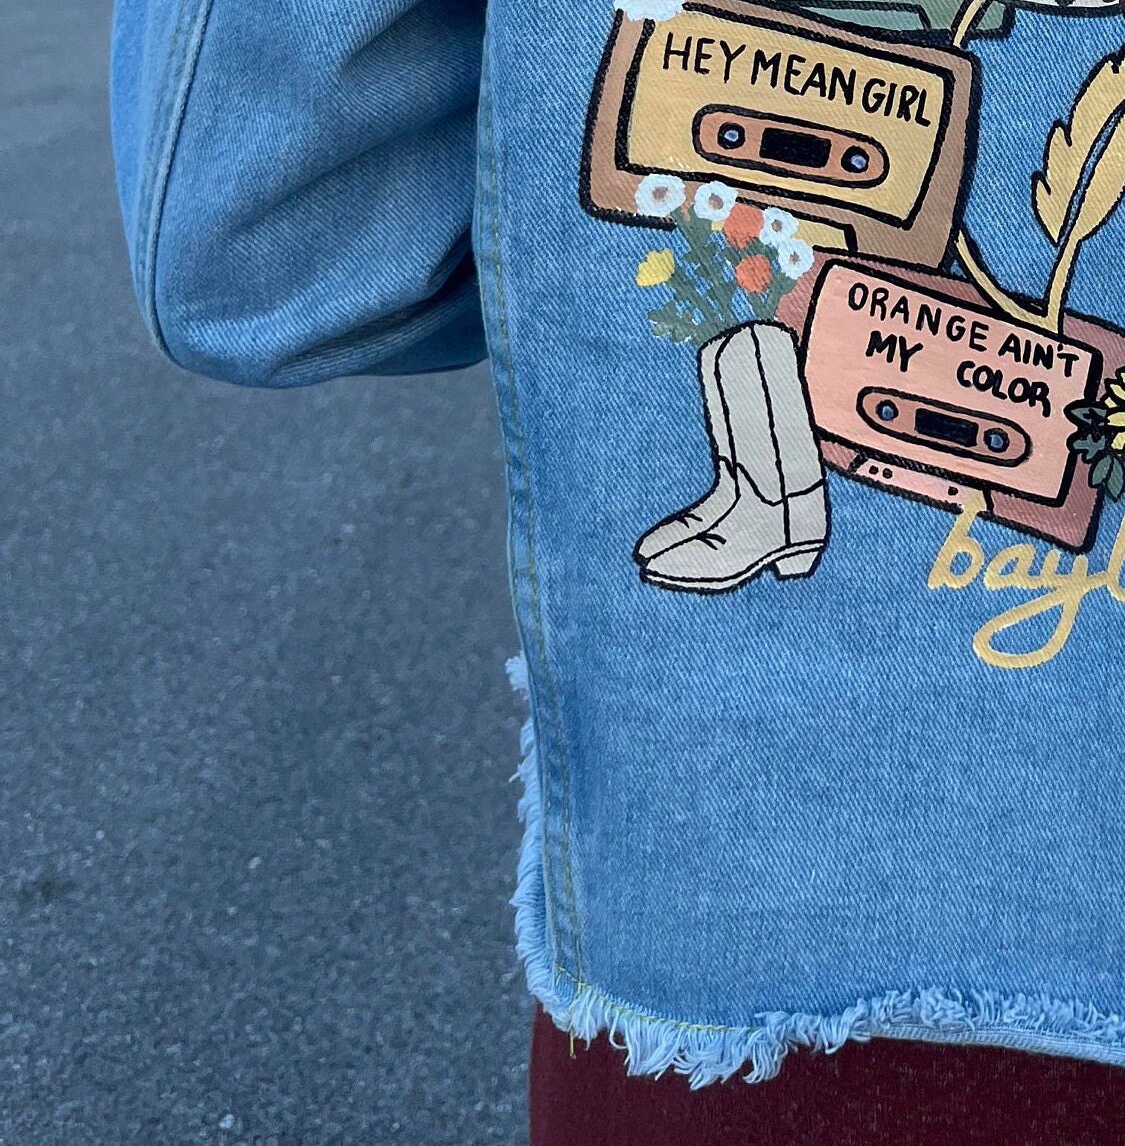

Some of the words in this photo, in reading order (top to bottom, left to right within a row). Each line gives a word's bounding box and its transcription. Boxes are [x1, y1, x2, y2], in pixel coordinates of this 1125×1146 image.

[662, 31, 747, 83] HEY
[751, 50, 857, 105] MEAN
[861, 78, 932, 127] GIRL
[848, 282, 989, 352] ORANGE
[998, 334, 1080, 377] AIN'T
[865, 330, 924, 372] MY
[956, 360, 1051, 417] COLOR
